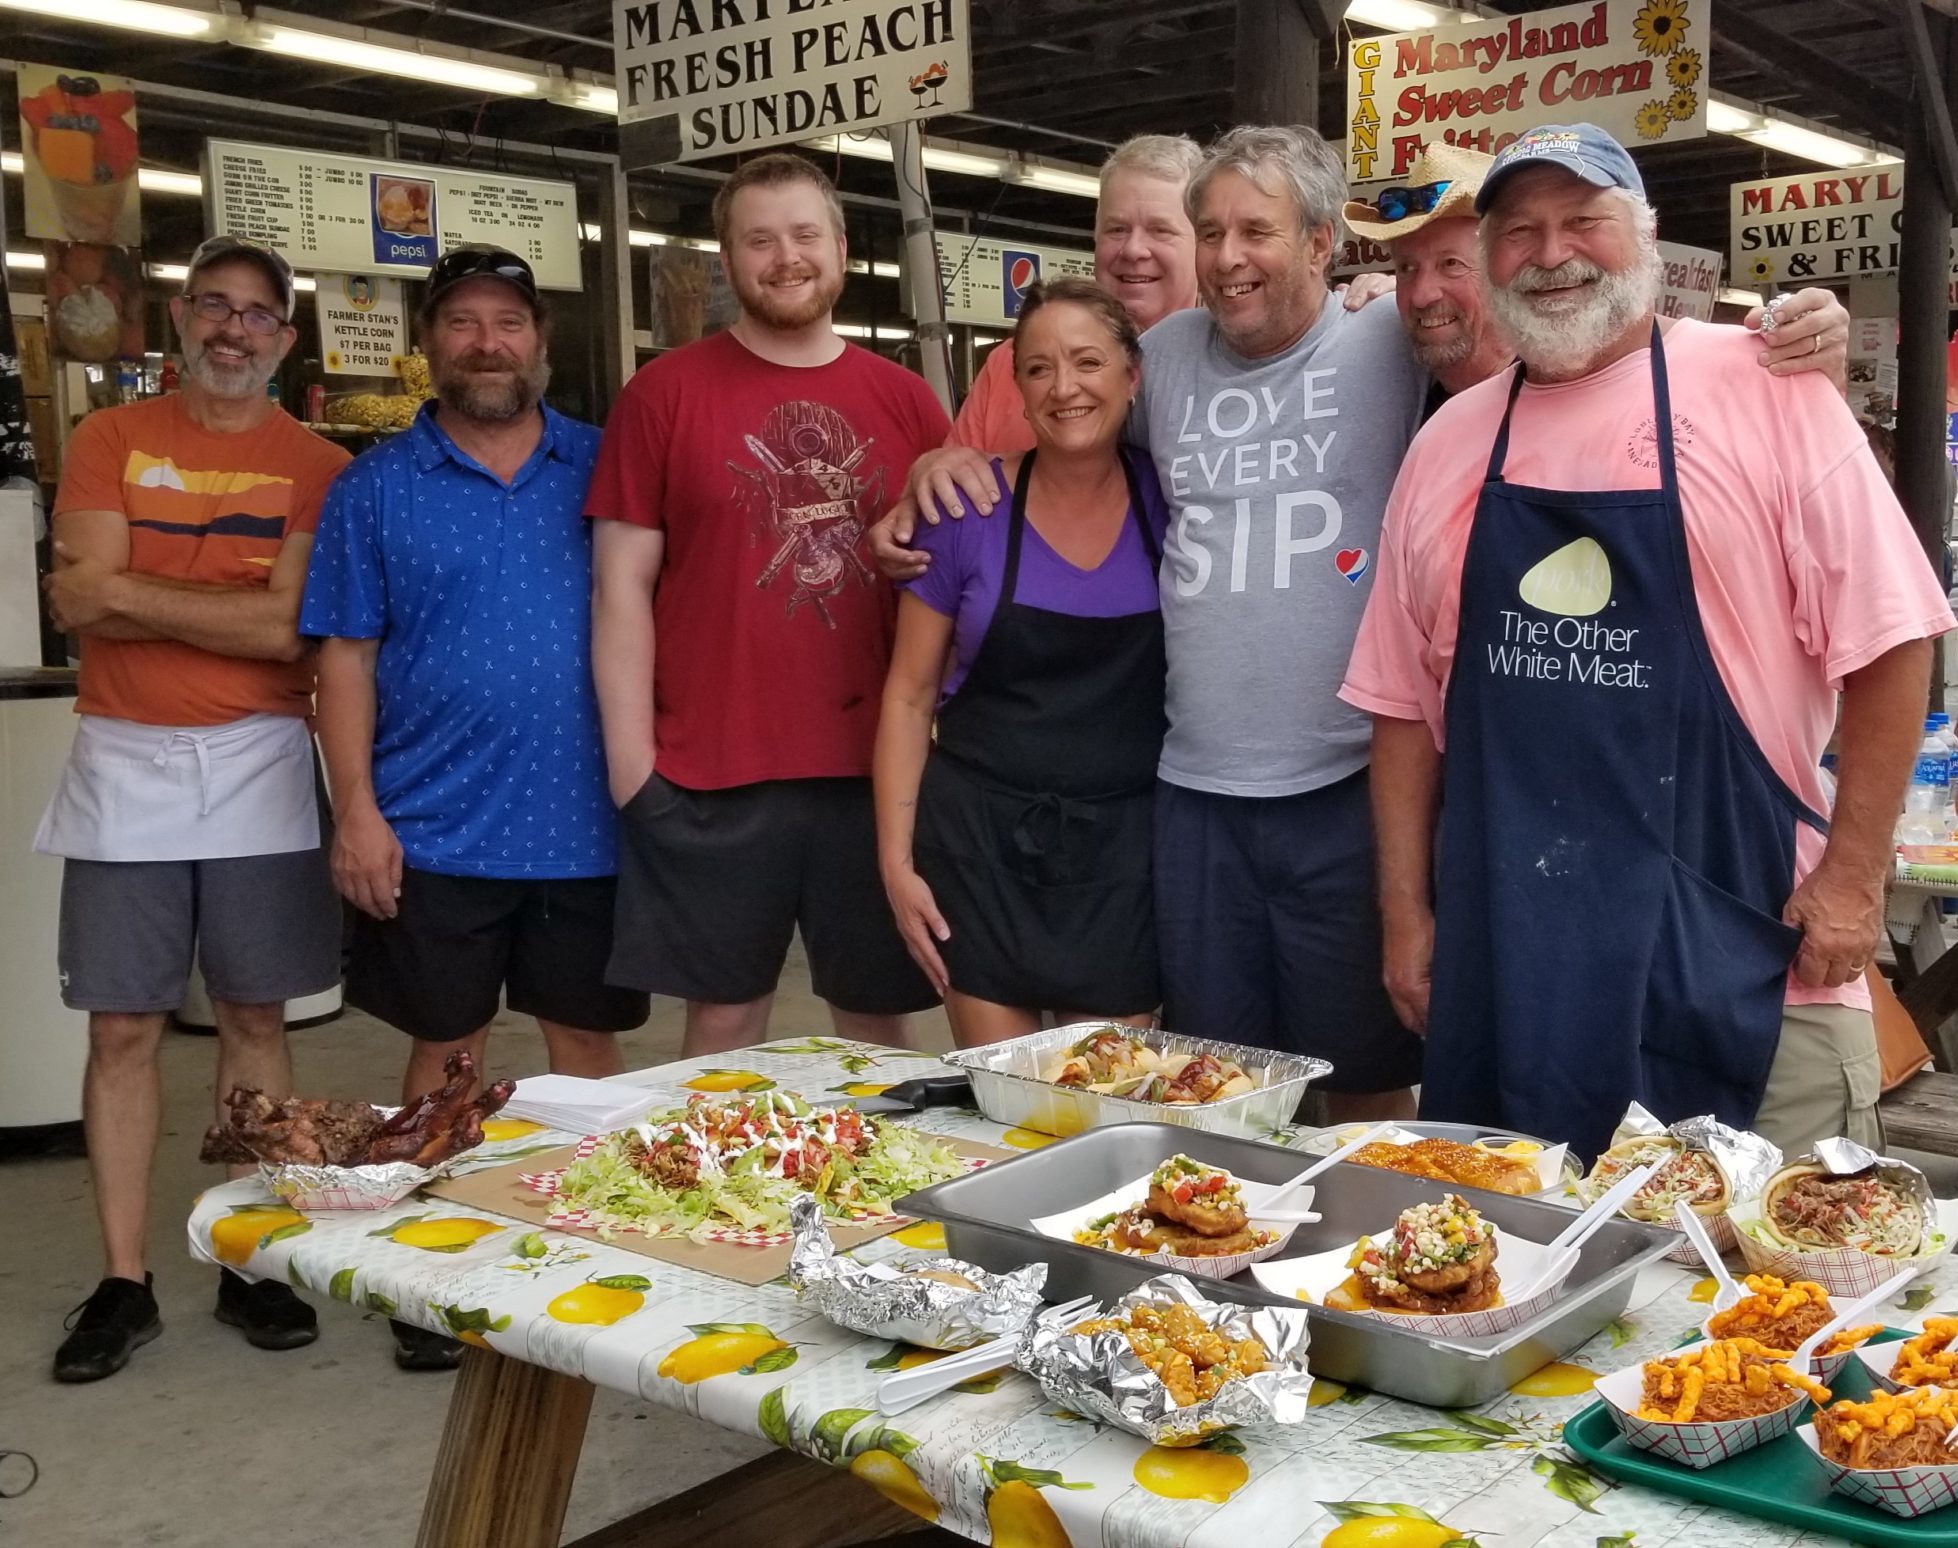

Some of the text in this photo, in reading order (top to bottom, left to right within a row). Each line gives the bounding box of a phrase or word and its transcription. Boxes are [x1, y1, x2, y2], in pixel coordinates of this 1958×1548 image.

[625, 0, 955, 107] FRESH PEACH
[1393, 4, 1609, 79] Maryland
[692, 74, 882, 150] SUNDAE
[1352, 41, 1381, 179] GIANT
[1392, 59, 1654, 129] Sweet Corn
[1533, 140, 1581, 153] MEADOW
[1741, 213, 1874, 251] SWEET
[391, 244, 426, 259] pepsi
[1787, 252, 1818, 277] &
[327, 310, 399, 325] FARMER STAN'S
[334, 325, 394, 338] KETTLE CORN
[340, 340, 391, 352] $7 PER BAG
[345, 354, 389, 366] 3 FOR $20
[1177, 368, 1339, 443] LOVE
[1680, 417, 1695, 436] BAY
[1170, 430, 1337, 497] EVERY
[1176, 489, 1343, 597] SIP
[1500, 611, 1640, 652] The Other
[1488, 644, 1561, 680] White
